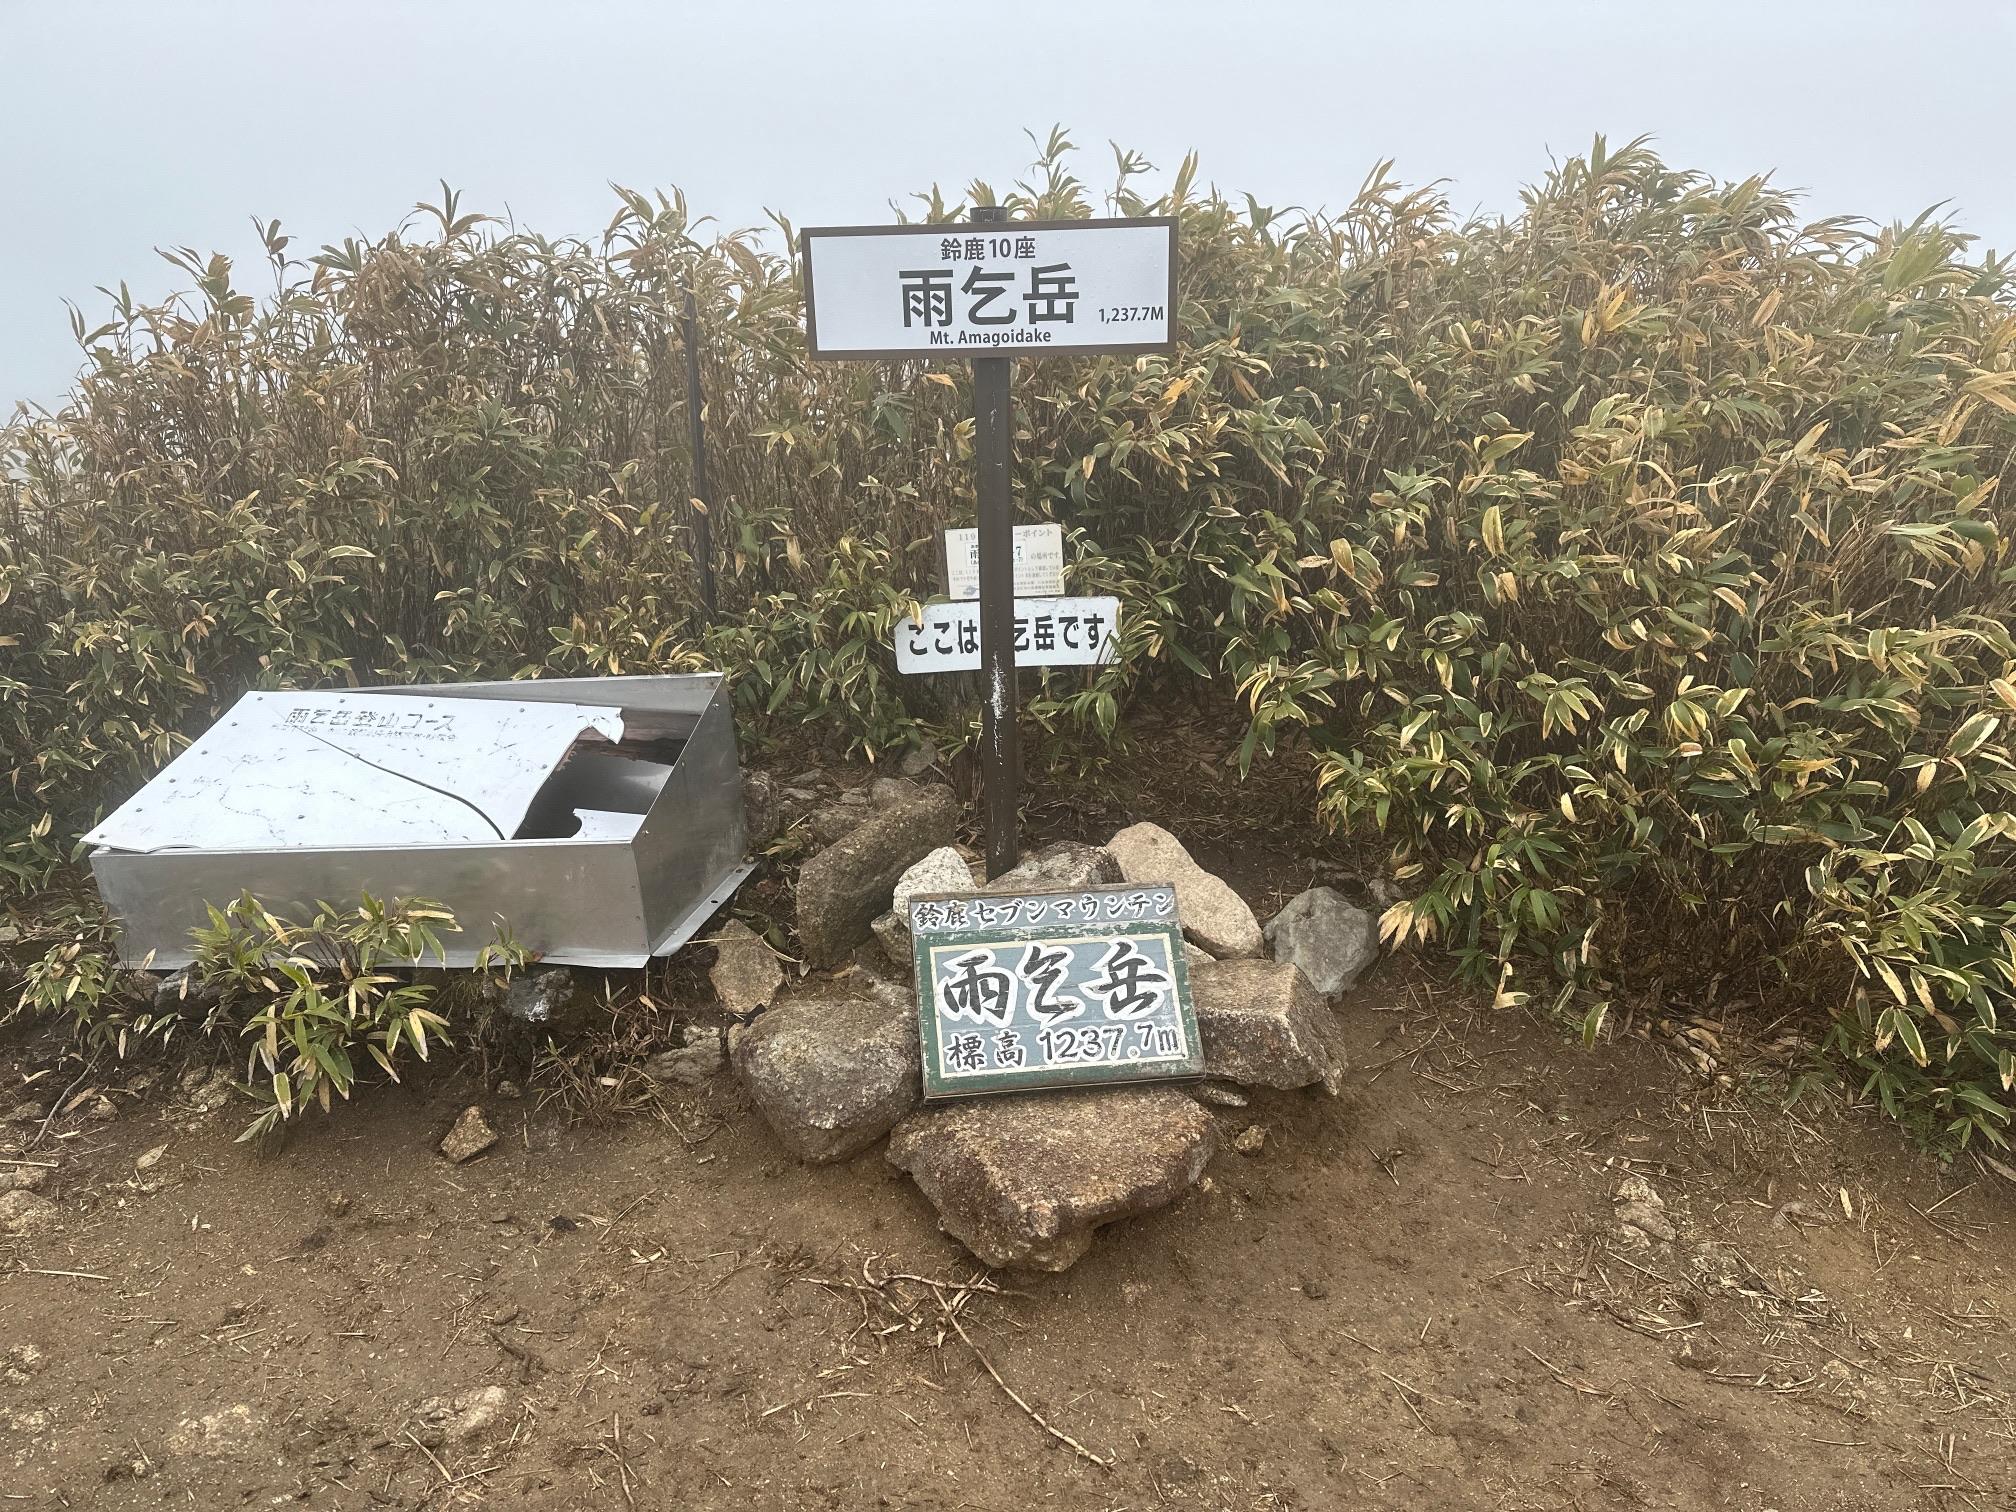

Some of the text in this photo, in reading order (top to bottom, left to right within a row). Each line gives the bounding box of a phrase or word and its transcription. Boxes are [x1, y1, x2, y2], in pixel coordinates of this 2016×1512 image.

[940, 236, 1036, 261] 鈴鹿10座
[898, 262, 1080, 328] 雨乞岳
[1098, 306, 1164, 323] 1,237.7M
[929, 328, 1052, 347] Mt. Amagoidake
[913, 893, 1175, 929] 鈴鹿セブンマウンテン
[941, 940, 1169, 1025] 雨乞岳
[947, 1023, 1179, 1071] 標高 1237.7m
